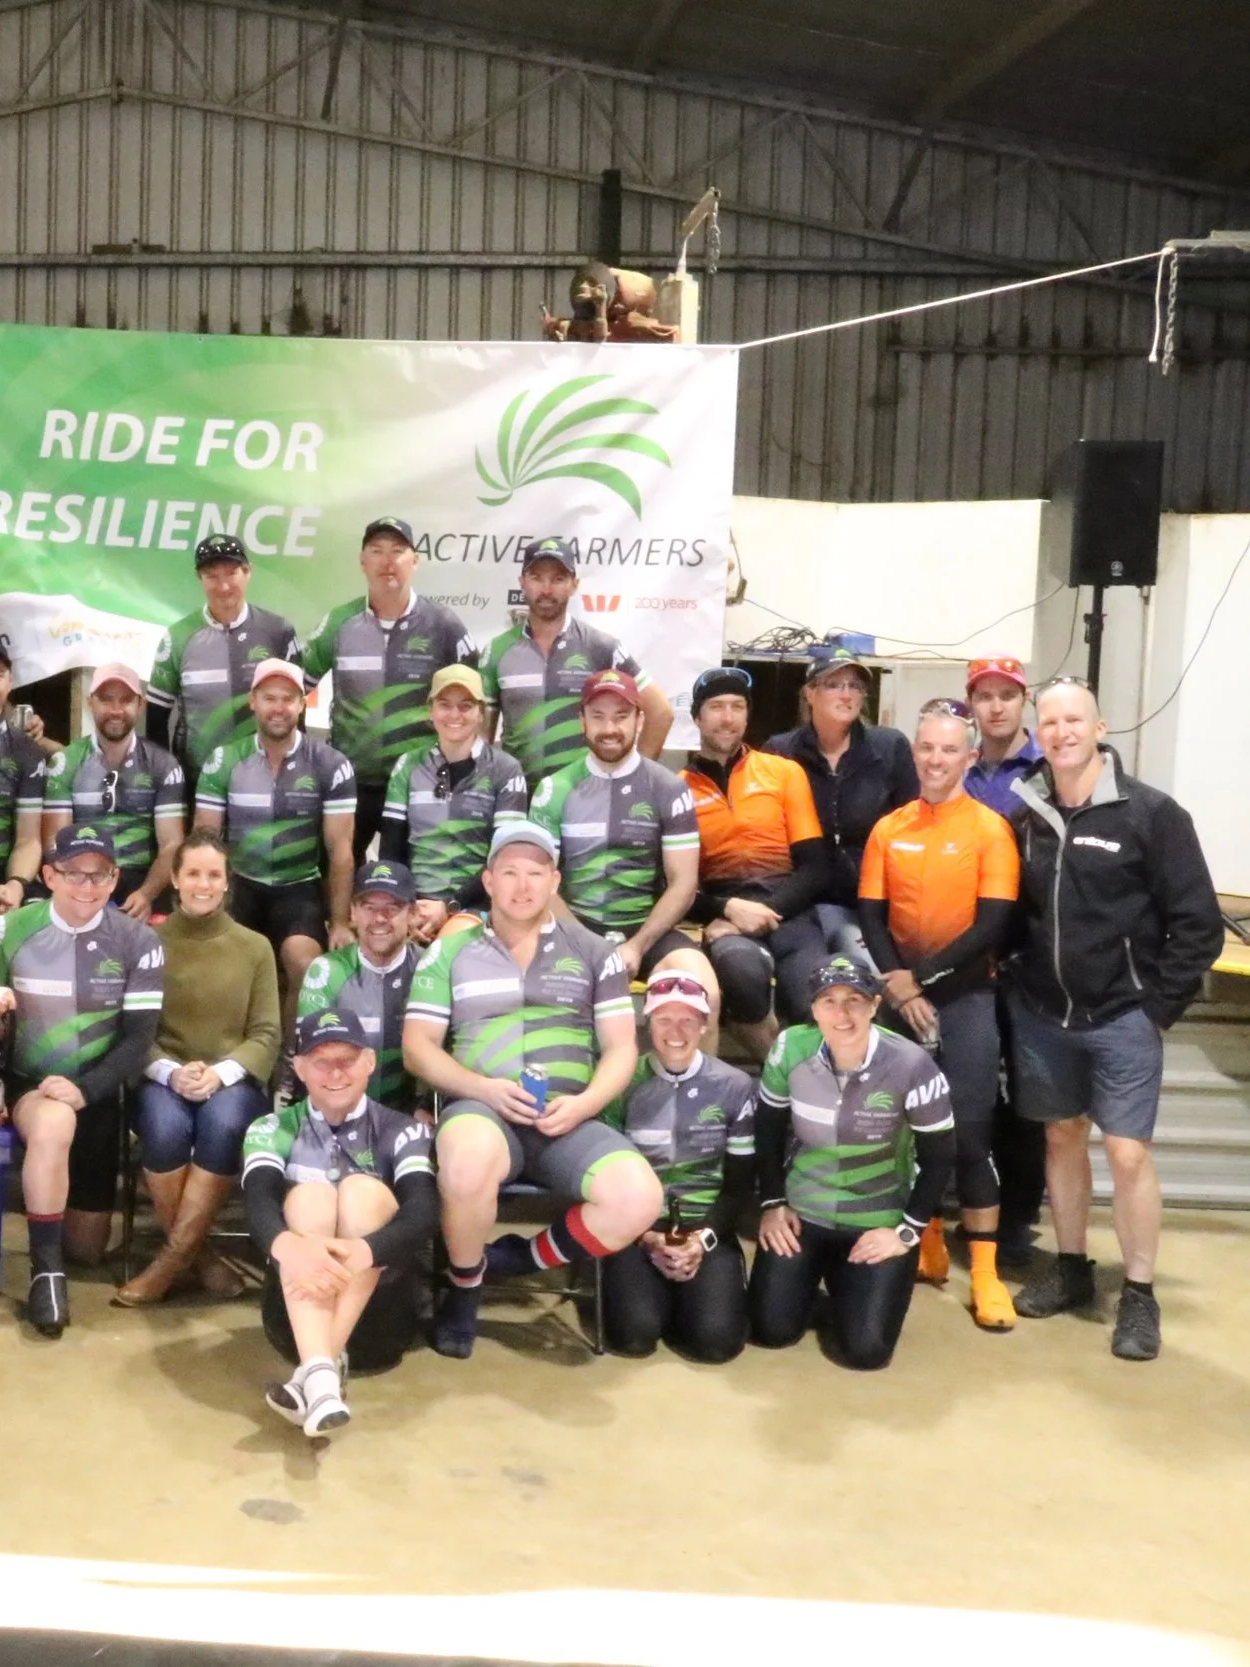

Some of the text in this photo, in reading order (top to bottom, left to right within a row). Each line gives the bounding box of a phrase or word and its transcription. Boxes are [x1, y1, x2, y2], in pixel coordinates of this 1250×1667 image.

[39, 410, 324, 473] RIDE FOR
[414, 532, 707, 568] ACTIVE ARMERS
[472, 593, 491, 610] by
[661, 597, 698, 611] years
